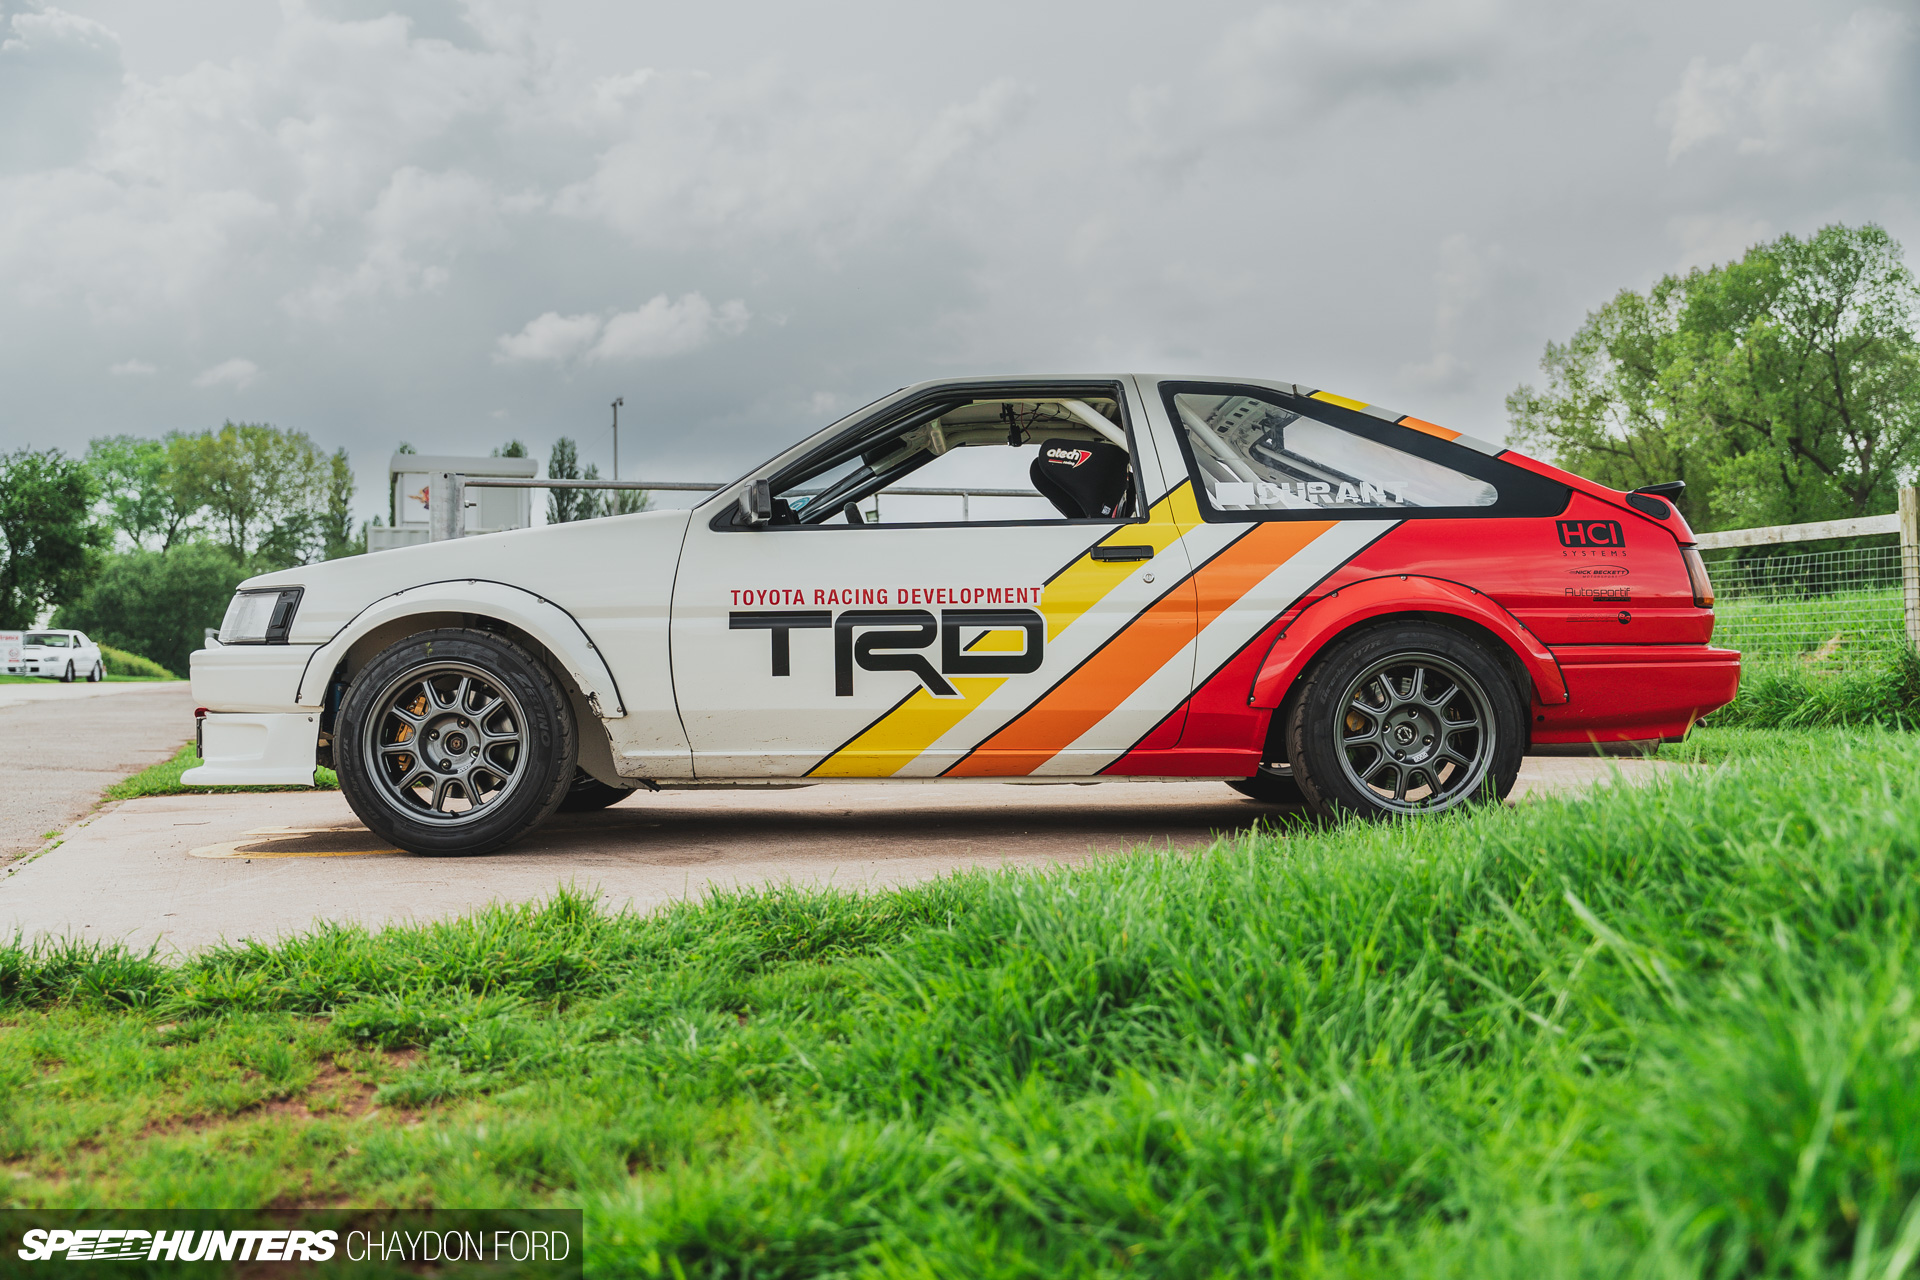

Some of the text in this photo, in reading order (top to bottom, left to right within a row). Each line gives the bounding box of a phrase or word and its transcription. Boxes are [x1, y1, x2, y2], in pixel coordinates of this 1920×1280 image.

[1046, 448, 1080, 461] atech
[1257, 481, 1409, 505] DURANT
[1561, 523, 1618, 545] HCI
[730, 587, 1041, 605] TOYOTA RACING DEVELOPMENT
[1564, 587, 1631, 597] Autosportif
[729, 608, 1044, 697] TRD
[509, 671, 551, 748] ZESTINO
